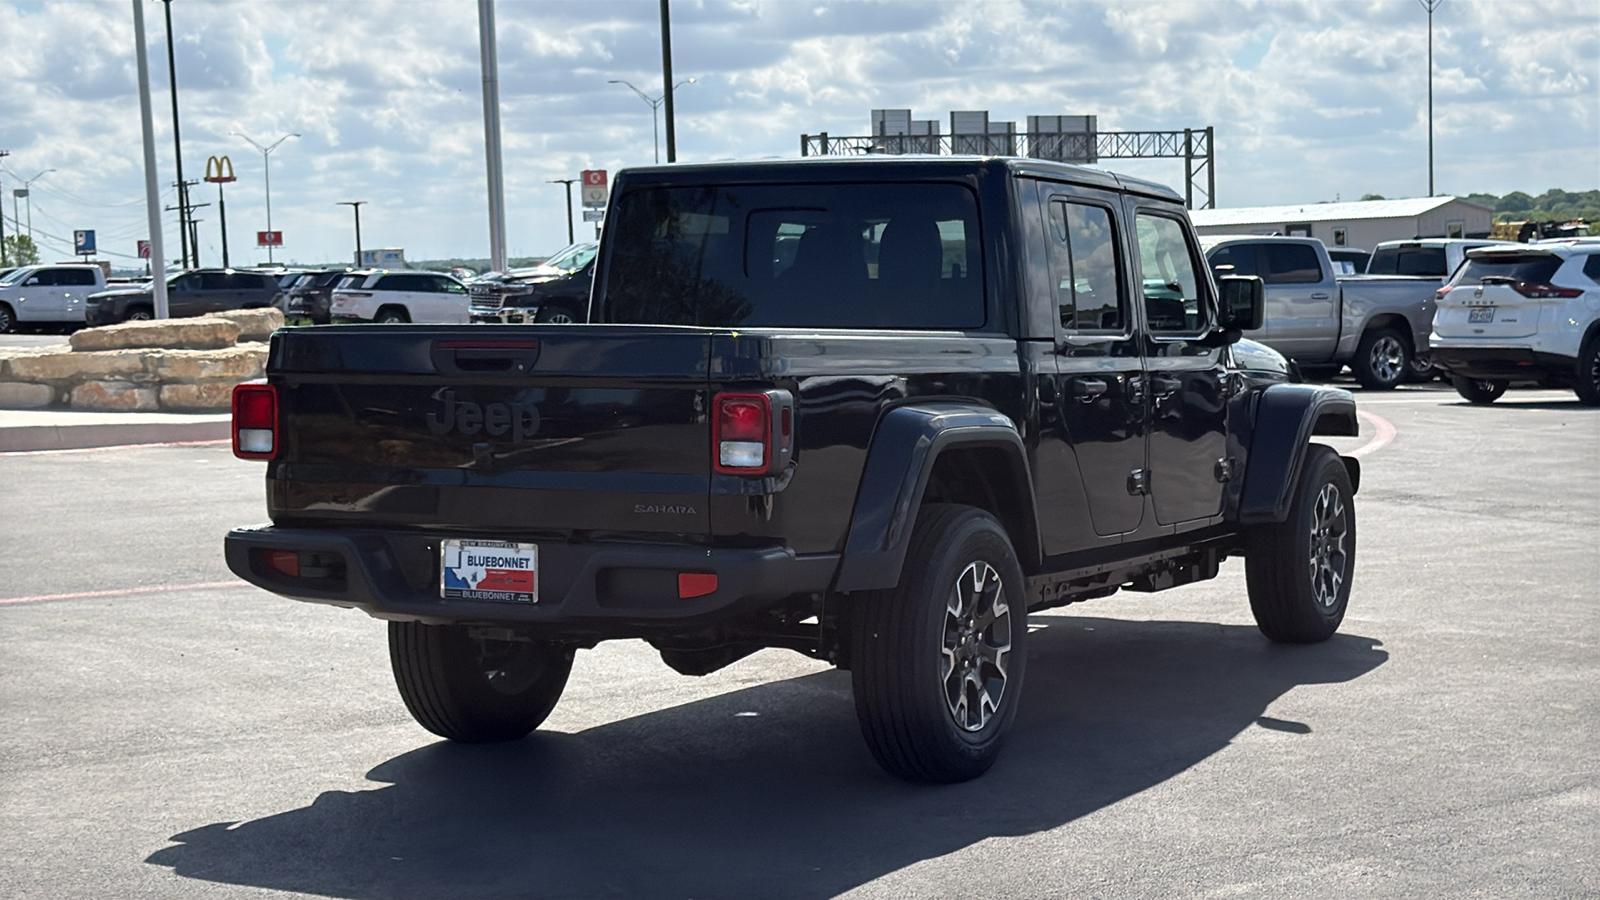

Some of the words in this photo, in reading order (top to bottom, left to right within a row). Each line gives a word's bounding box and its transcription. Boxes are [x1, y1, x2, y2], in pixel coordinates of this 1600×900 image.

[426, 389, 540, 444] Jeep
[634, 504, 697, 515] SAHARA
[467, 555, 530, 569] BLUEBONNET
[462, 591, 516, 601] BLUEBONNET
